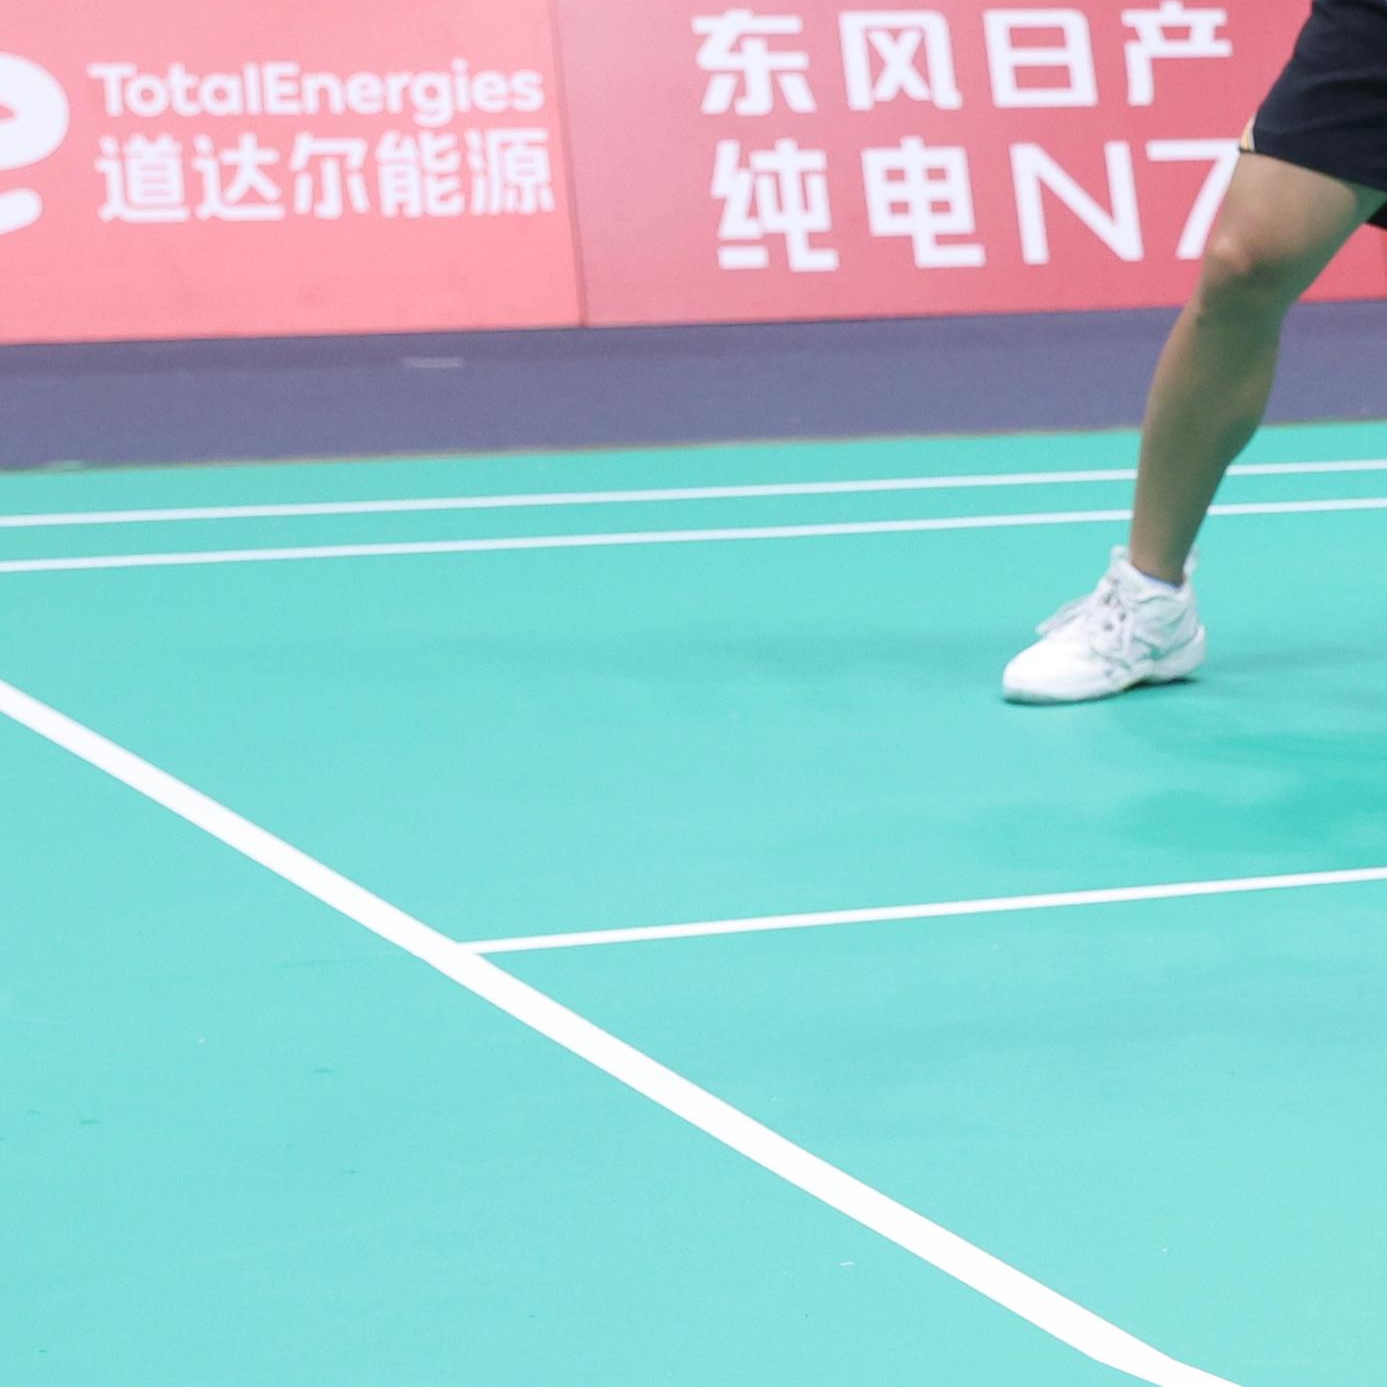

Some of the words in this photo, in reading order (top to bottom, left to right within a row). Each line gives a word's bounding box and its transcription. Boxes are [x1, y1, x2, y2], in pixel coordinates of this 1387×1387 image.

[88, 59, 544, 127] TotalEnergies
[692, 0, 1233, 116] 东风日产
[94, 128, 557, 224] 道达尔能源
